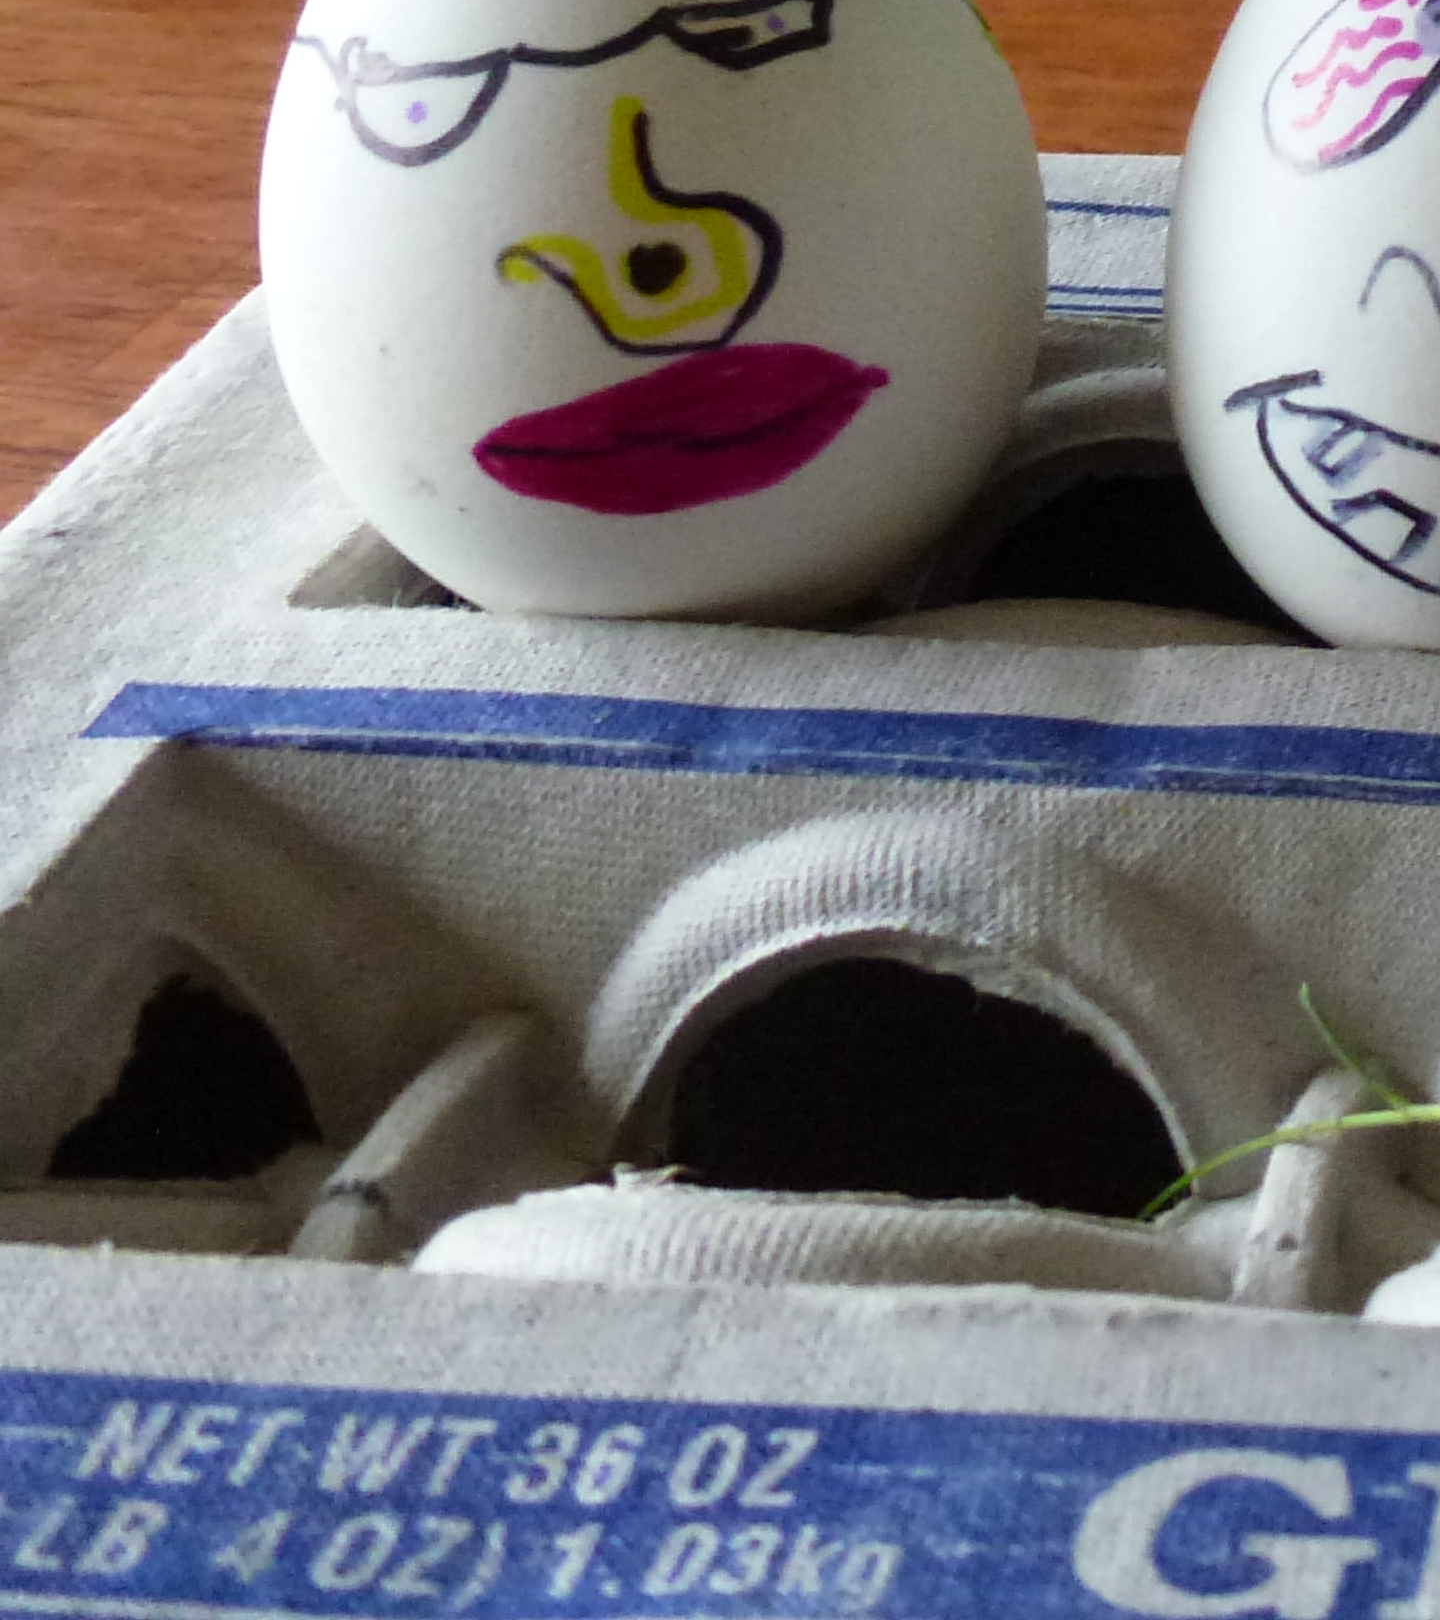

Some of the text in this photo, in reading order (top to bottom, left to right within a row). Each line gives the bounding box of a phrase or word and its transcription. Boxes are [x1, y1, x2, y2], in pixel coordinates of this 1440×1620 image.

[73, 1398, 819, 1510] NET WT 36 OZ
[12, 1493, 170, 1576] LB
[310, 1510, 507, 1613] OZ)
